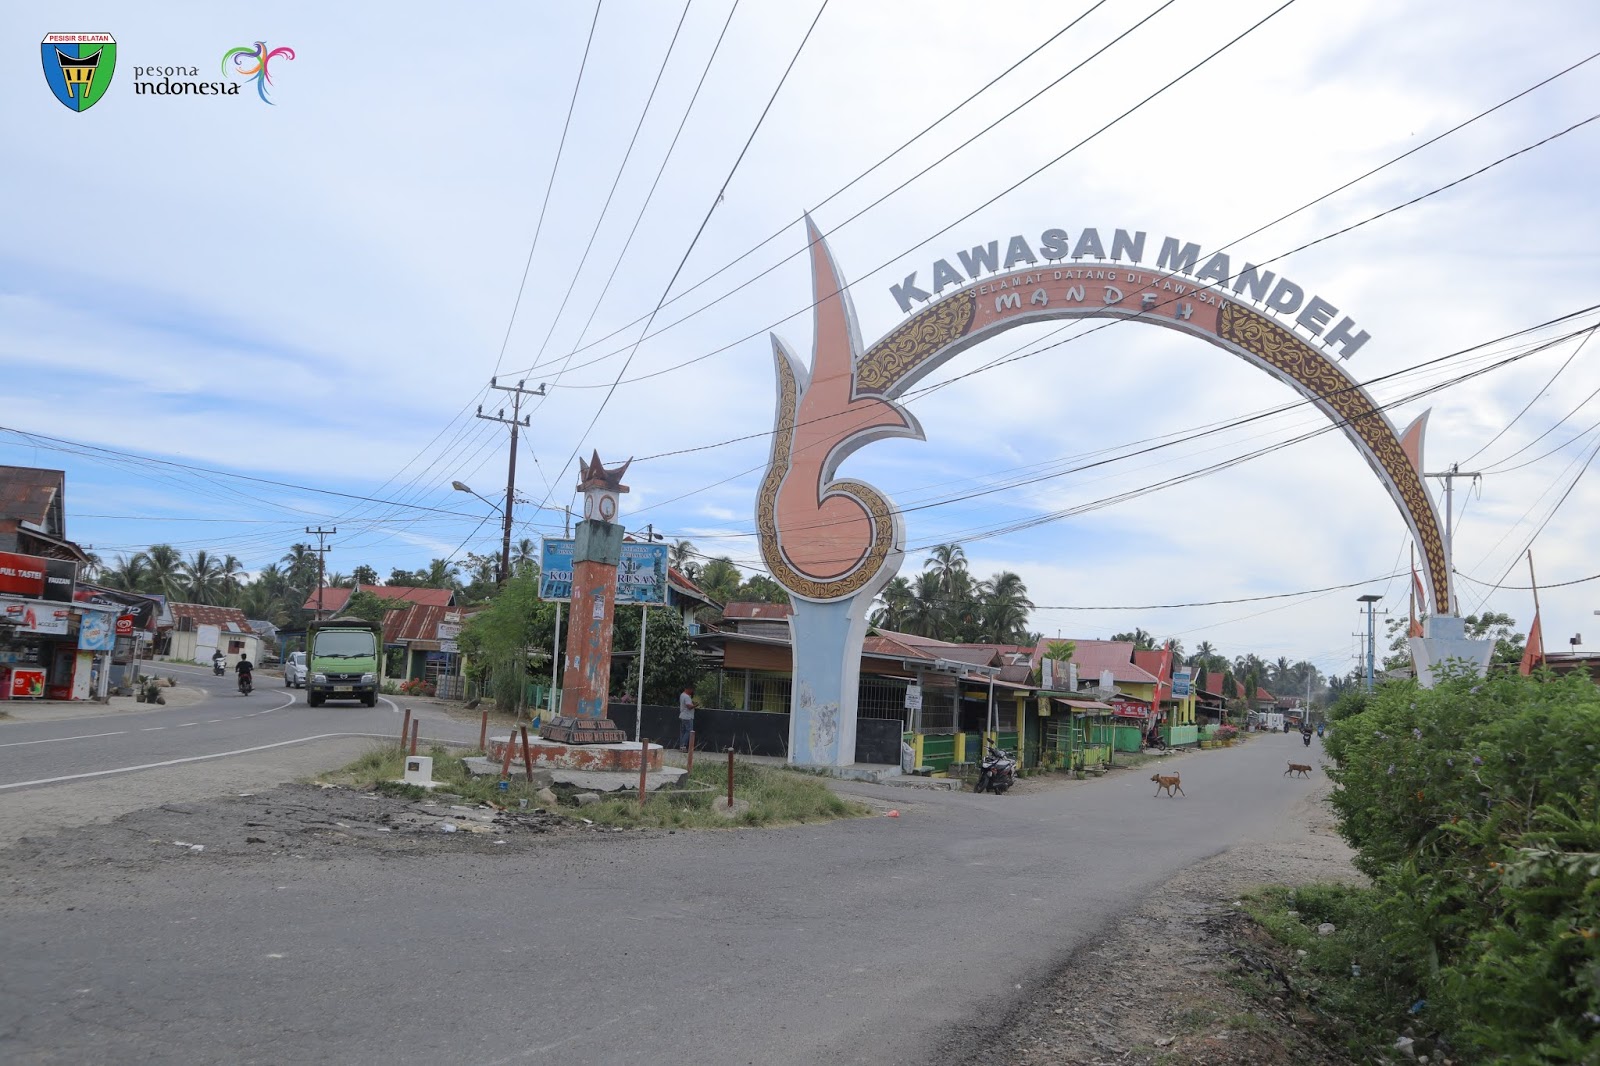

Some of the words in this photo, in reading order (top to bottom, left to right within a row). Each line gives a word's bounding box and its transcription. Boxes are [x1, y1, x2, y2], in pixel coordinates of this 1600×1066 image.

[889, 228, 1147, 314] KAWASAN
[1156, 236, 1372, 360] MANDEH
[970, 273, 1043, 298] SELAMAT
[1054, 270, 1116, 281] DATANG
[1127, 273, 1142, 284] DI
[1152, 277, 1230, 310] KAWASAN
[617, 574, 656, 584] RUSAN
